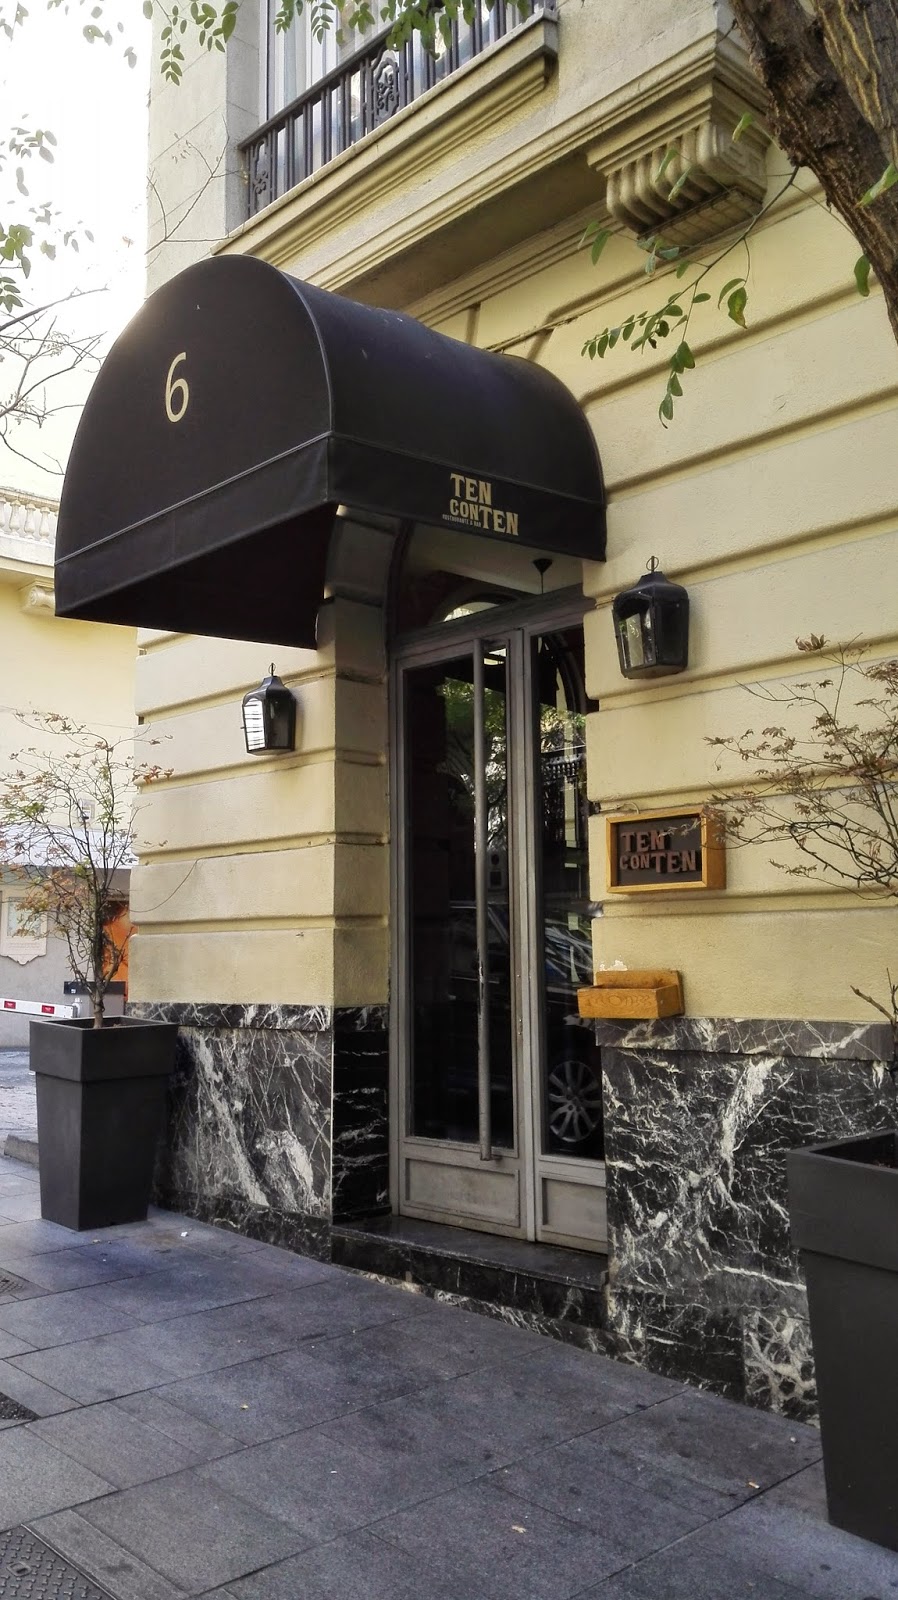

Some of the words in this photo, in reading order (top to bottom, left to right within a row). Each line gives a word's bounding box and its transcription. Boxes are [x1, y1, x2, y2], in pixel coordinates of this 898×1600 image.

[165, 351, 189, 423] 6
[450, 473, 492, 505] TEN
[449, 498, 518, 536] CONTEN
[620, 829, 665, 852] TEN
[619, 849, 696, 873] CONTEN
